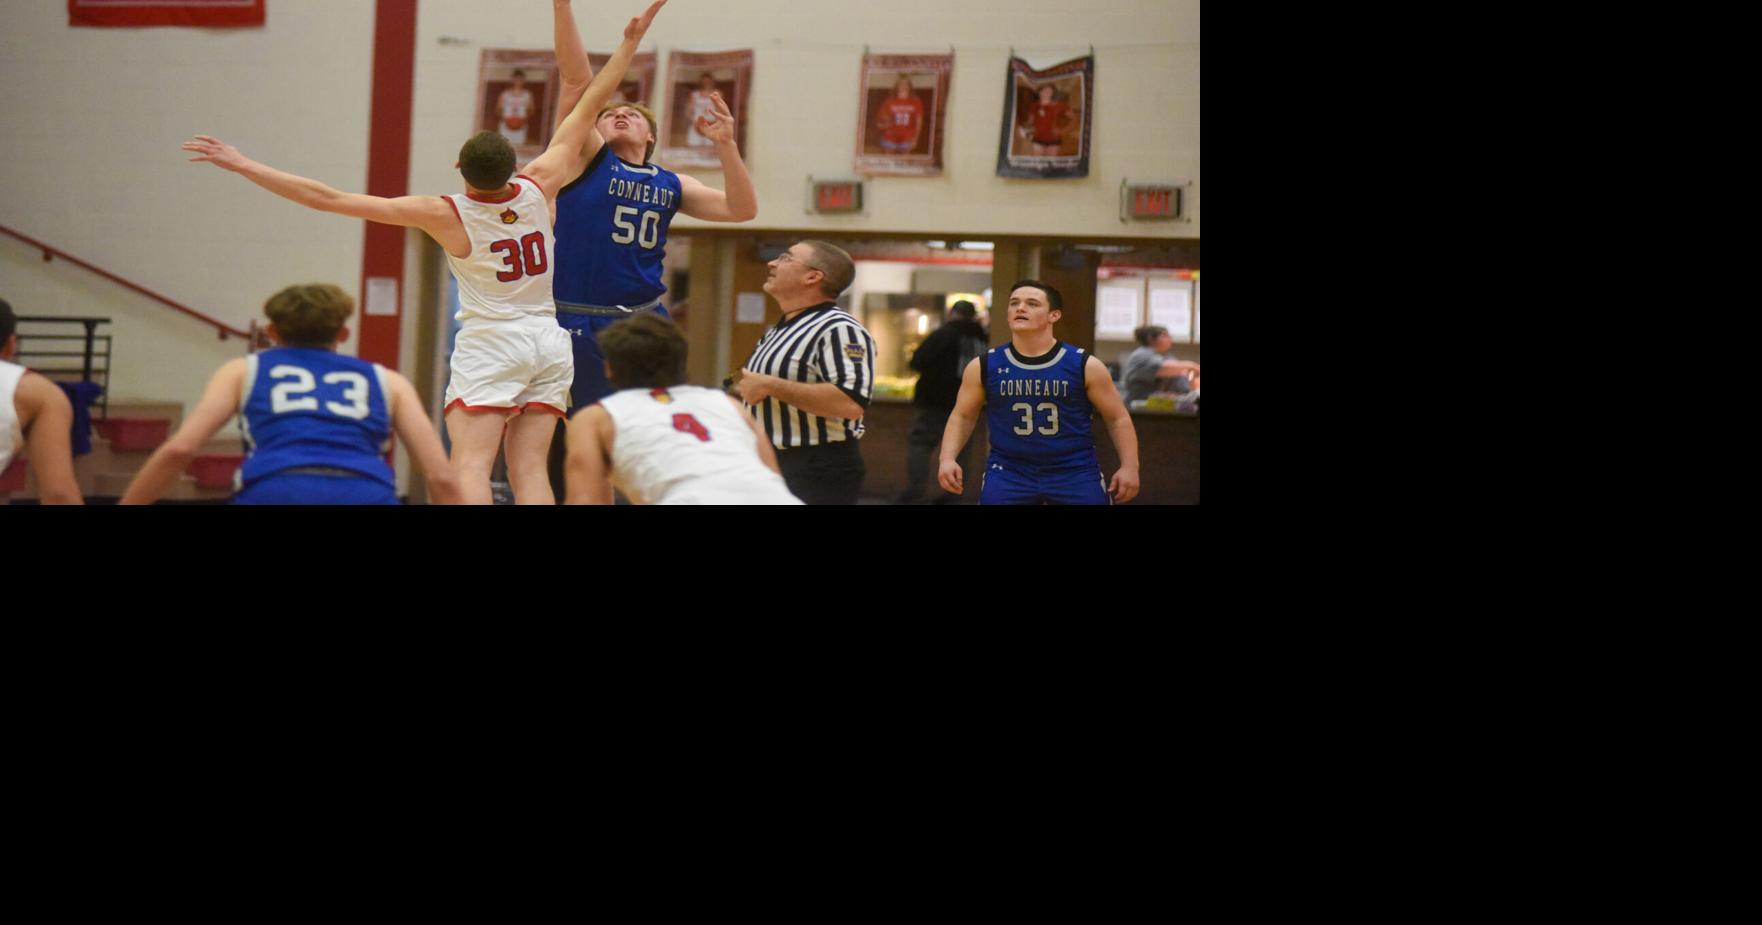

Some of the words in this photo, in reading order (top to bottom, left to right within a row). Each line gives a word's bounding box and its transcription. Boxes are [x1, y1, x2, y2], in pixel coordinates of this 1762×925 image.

[608, 177, 676, 209] CONNEAUT
[611, 204, 661, 250] 50
[490, 230, 548, 283] 30
[269, 364, 370, 420] 23
[1000, 379, 1069, 397] CONNEAUT
[672, 413, 711, 442] 4
[1011, 402, 1060, 436] 33
